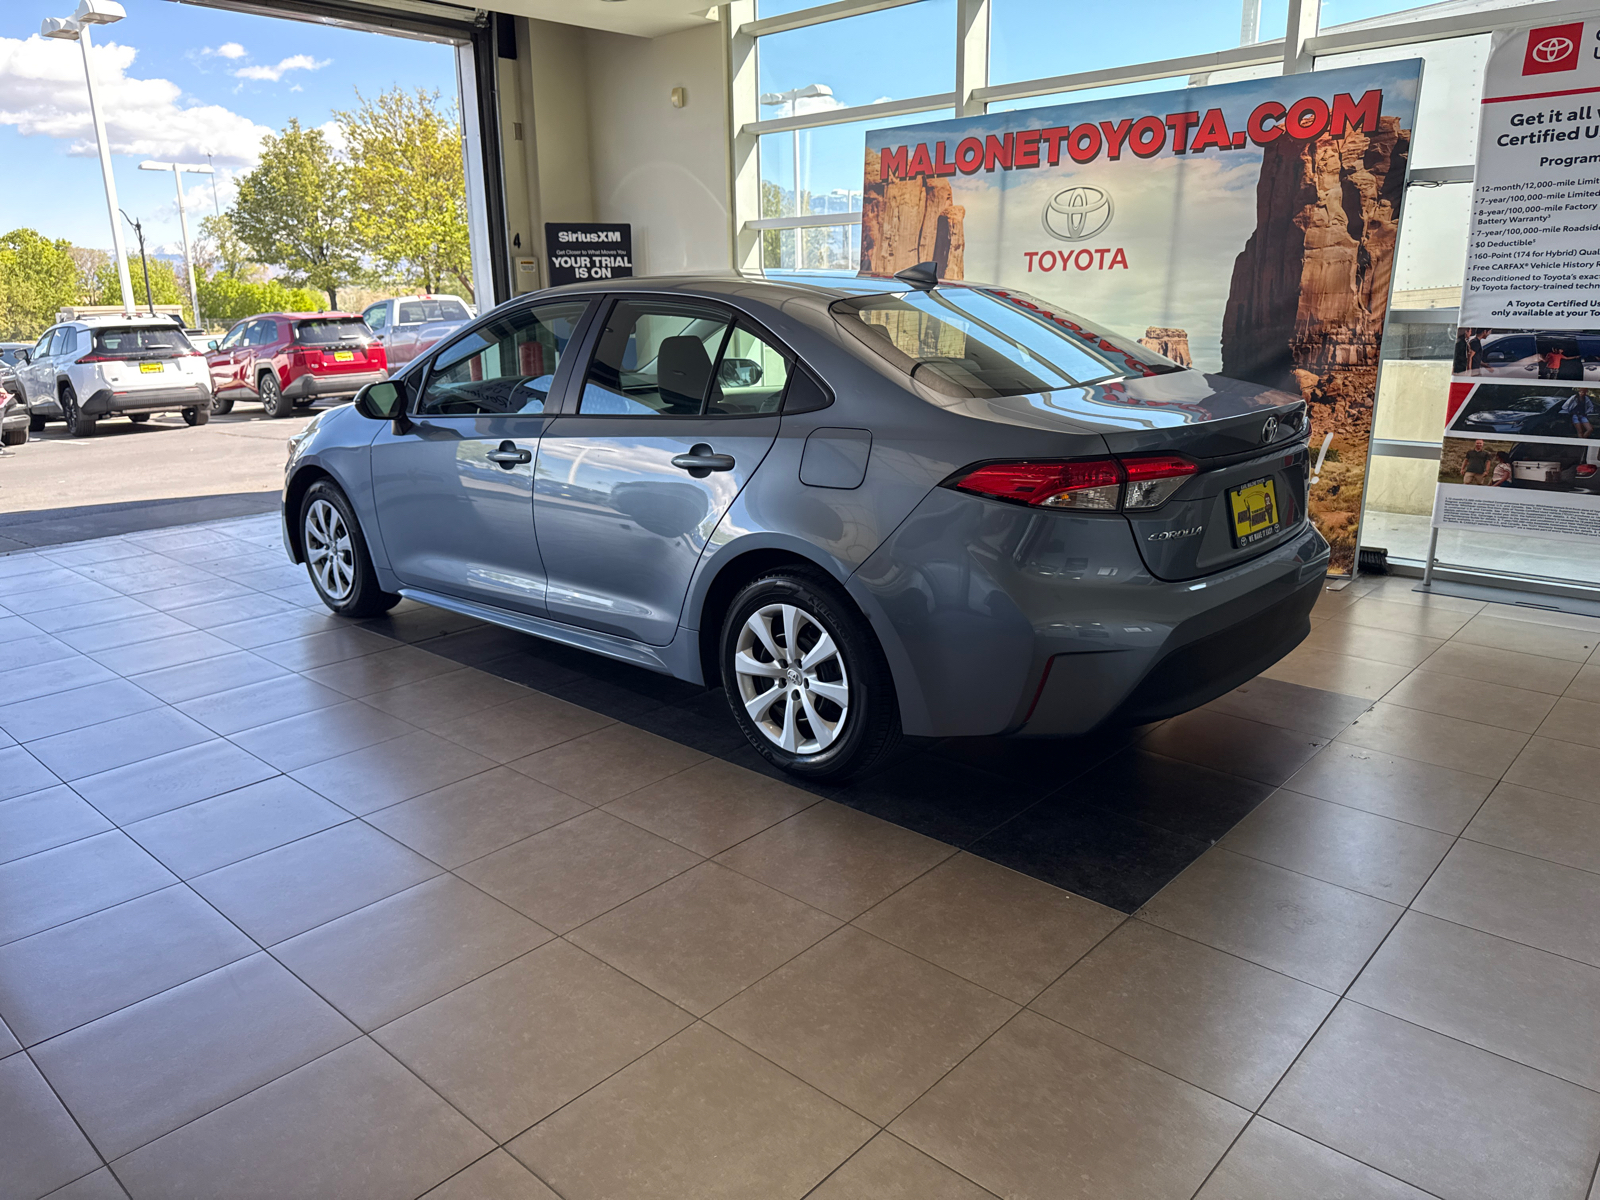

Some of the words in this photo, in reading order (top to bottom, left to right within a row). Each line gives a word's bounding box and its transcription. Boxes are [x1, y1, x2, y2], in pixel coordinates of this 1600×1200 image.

[1510, 112, 1544, 127] Get
[1548, 109, 1562, 123] it
[1566, 105, 1592, 121] all
[880, 89, 1383, 183] MALONETOYOTA.COM
[1497, 126, 1580, 147] Certified
[1481, 179, 1575, 193] 12-month/12,000-mile
[1480, 191, 1565, 206] 7-year/100,000-mile
[1478, 205, 1563, 217] 8-year/100,000-mile
[1565, 203, 1598, 211] Factory
[1478, 218, 1507, 226] Battery
[558, 231, 621, 242] SiriusXM
[1477, 226, 1561, 238] 7-year/100,000-mile
[513, 232, 521, 249] 4
[1024, 248, 1129, 272] TOYOTA
[1474, 252, 1512, 260] 160-Point
[1513, 251, 1531, 259] (174
[1532, 250, 1544, 258] for
[1545, 249, 1577, 258] Hybrid)
[552, 256, 590, 268] YOUR
[592, 256, 632, 267] TRIAL
[1530, 261, 1561, 269] Vehicle
[1562, 261, 1594, 270] History
[575, 267, 589, 278] IS
[591, 267, 612, 278] ON
[1471, 274, 1531, 282] Reconditioned
[1543, 273, 1577, 282] Toyota's
[1470, 284, 1481, 292] by
[1482, 284, 1508, 292] Toyota
[1510, 283, 1573, 291] factory-trained
[1515, 300, 1545, 308] Toyota
[1547, 299, 1588, 307] Certified
[1491, 309, 1511, 317] only
[1512, 309, 1553, 317] available
[1566, 310, 1588, 318] your
[1148, 525, 1203, 541] COROLLA
